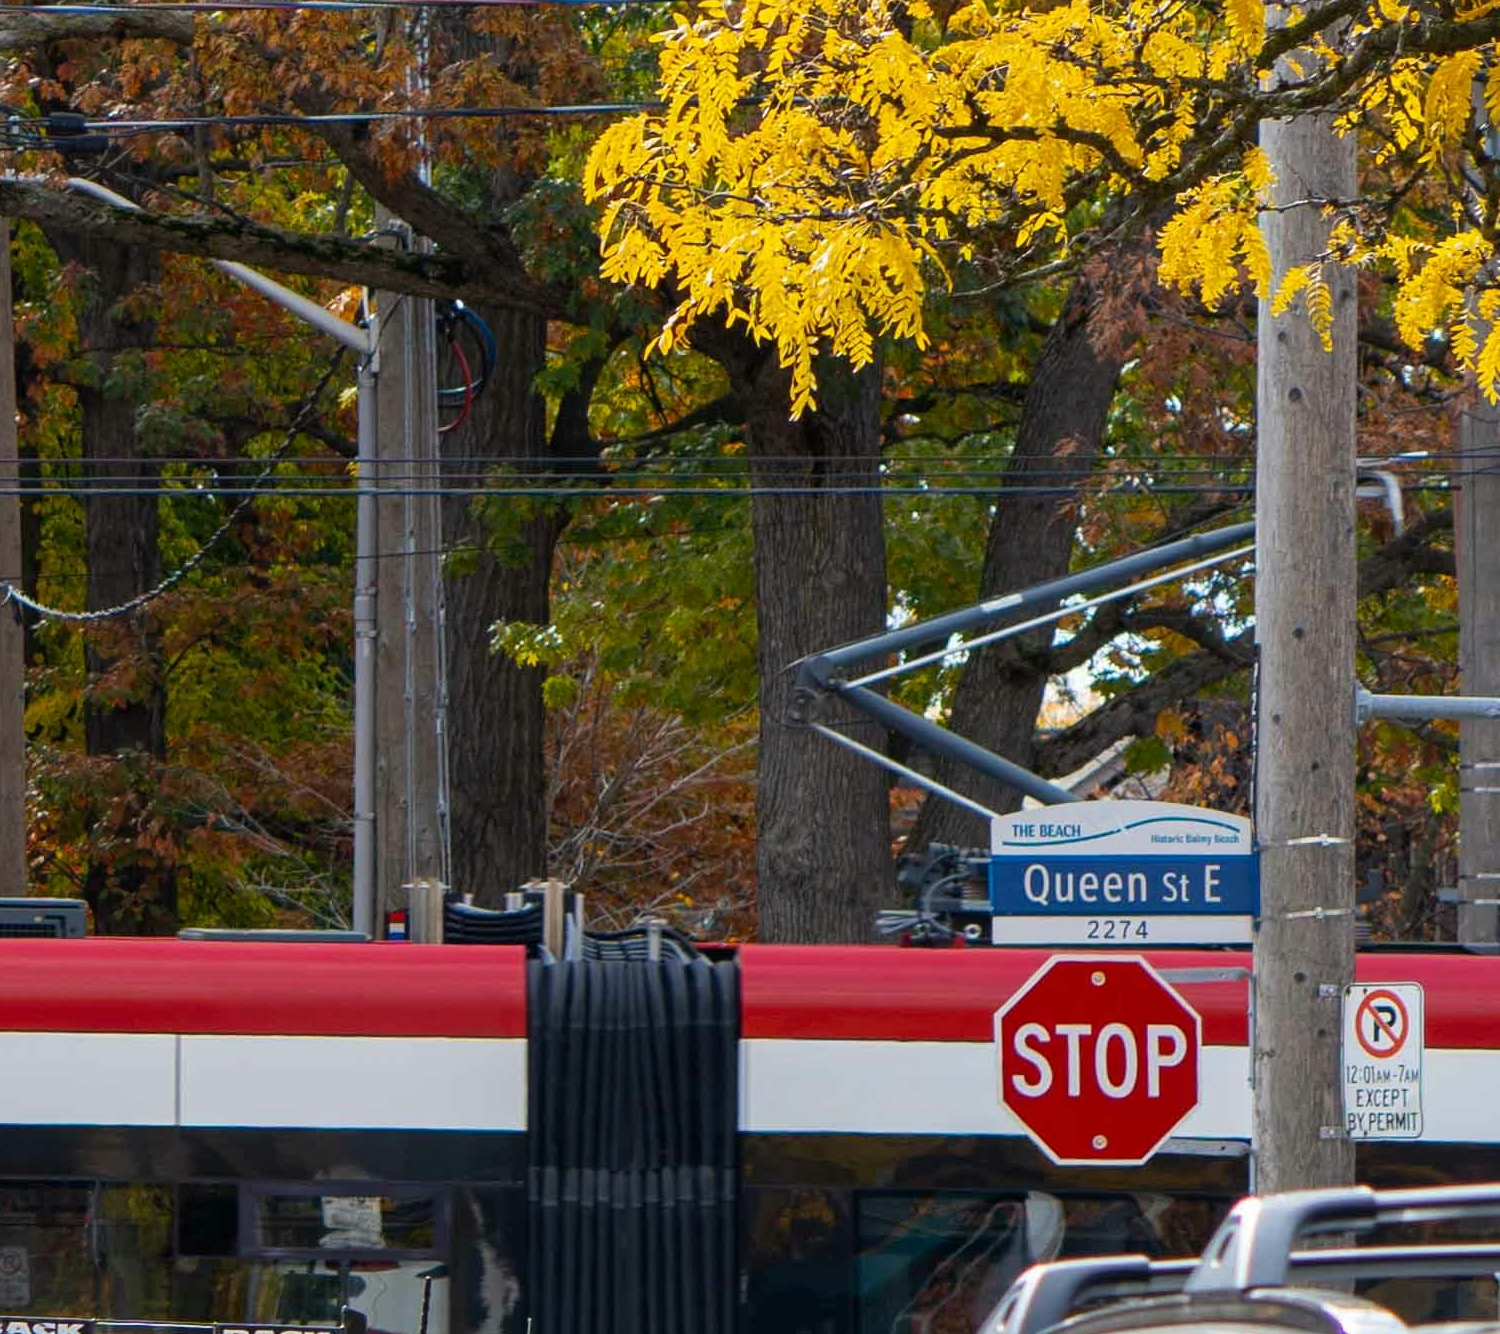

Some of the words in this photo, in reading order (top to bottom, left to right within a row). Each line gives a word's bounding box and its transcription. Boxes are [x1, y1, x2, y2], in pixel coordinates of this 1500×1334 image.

[1012, 824, 1037, 838] THE
[1039, 824, 1081, 837] BEACH
[1151, 834, 1184, 844] Historic
[1214, 834, 1239, 844] Beach
[1023, 863, 1148, 906] Queen
[1162, 871, 1190, 903] St
[1204, 864, 1221, 903] E
[1087, 920, 1149, 939] 2274
[1011, 1022, 1188, 1099] STOP
[1356, 1088, 1410, 1108] EXCEPT
[1348, 1113, 1365, 1131] BY
[1368, 1111, 1419, 1131] PERMIT
